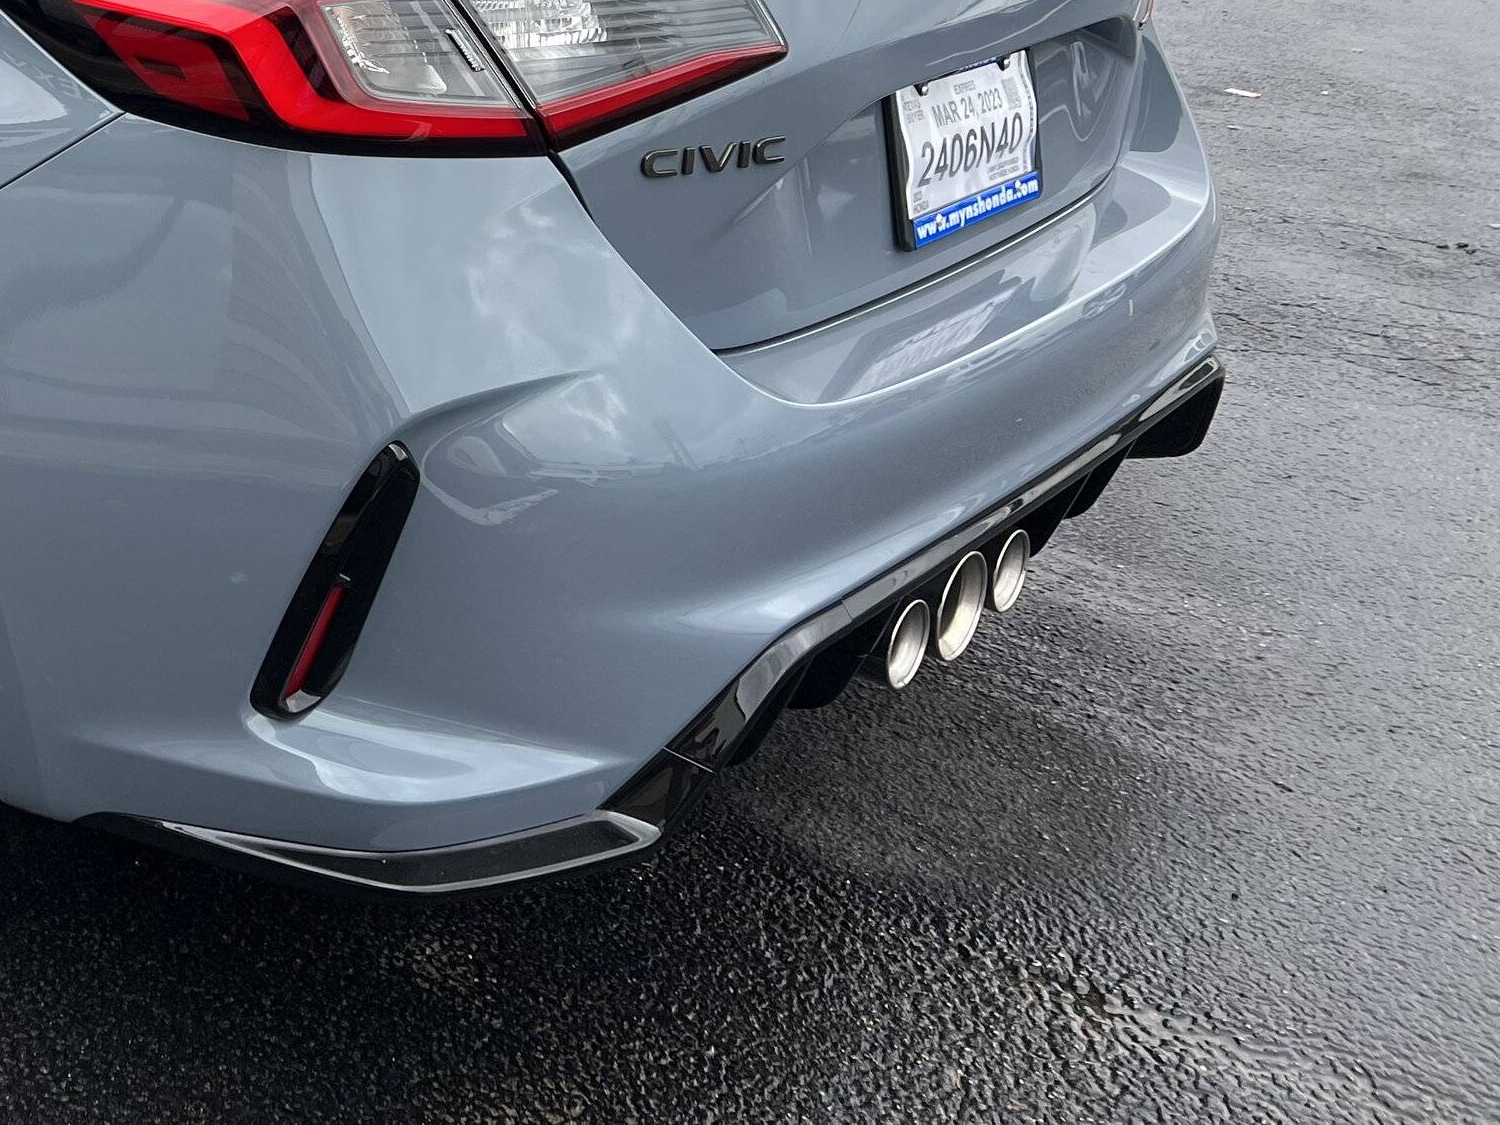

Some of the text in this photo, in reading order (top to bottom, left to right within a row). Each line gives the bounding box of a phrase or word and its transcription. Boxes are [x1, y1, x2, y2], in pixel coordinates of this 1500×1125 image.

[931, 87, 1003, 128] MAR 24, 2023
[640, 135, 787, 179] CIVIC
[917, 111, 1023, 187] 2406N40
